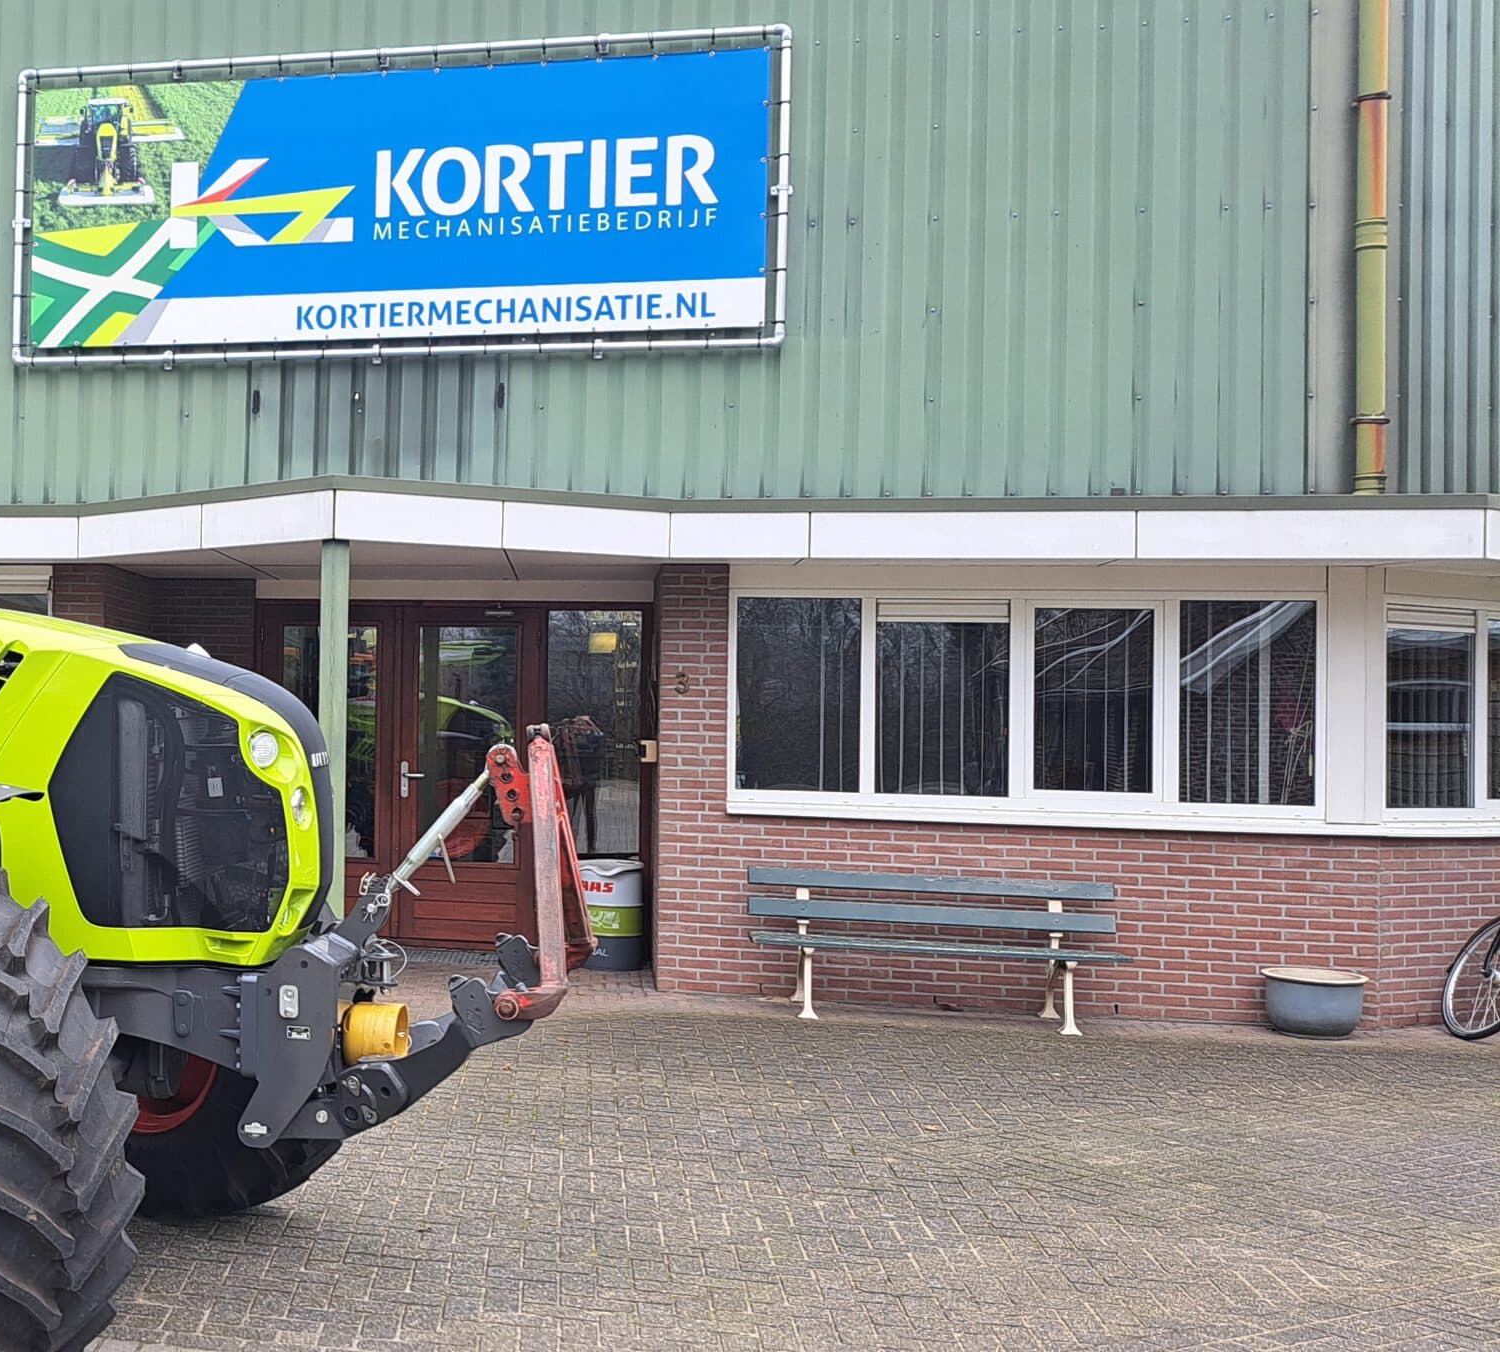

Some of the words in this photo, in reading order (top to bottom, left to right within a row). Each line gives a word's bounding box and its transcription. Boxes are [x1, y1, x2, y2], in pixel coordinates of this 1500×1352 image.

[374, 134, 719, 218] KORTIER
[373, 207, 718, 241] MECHANISATIEBEDRIJF
[295, 291, 717, 331] KORTIERMECHANISATIE.NL
[674, 671, 690, 695] 3
